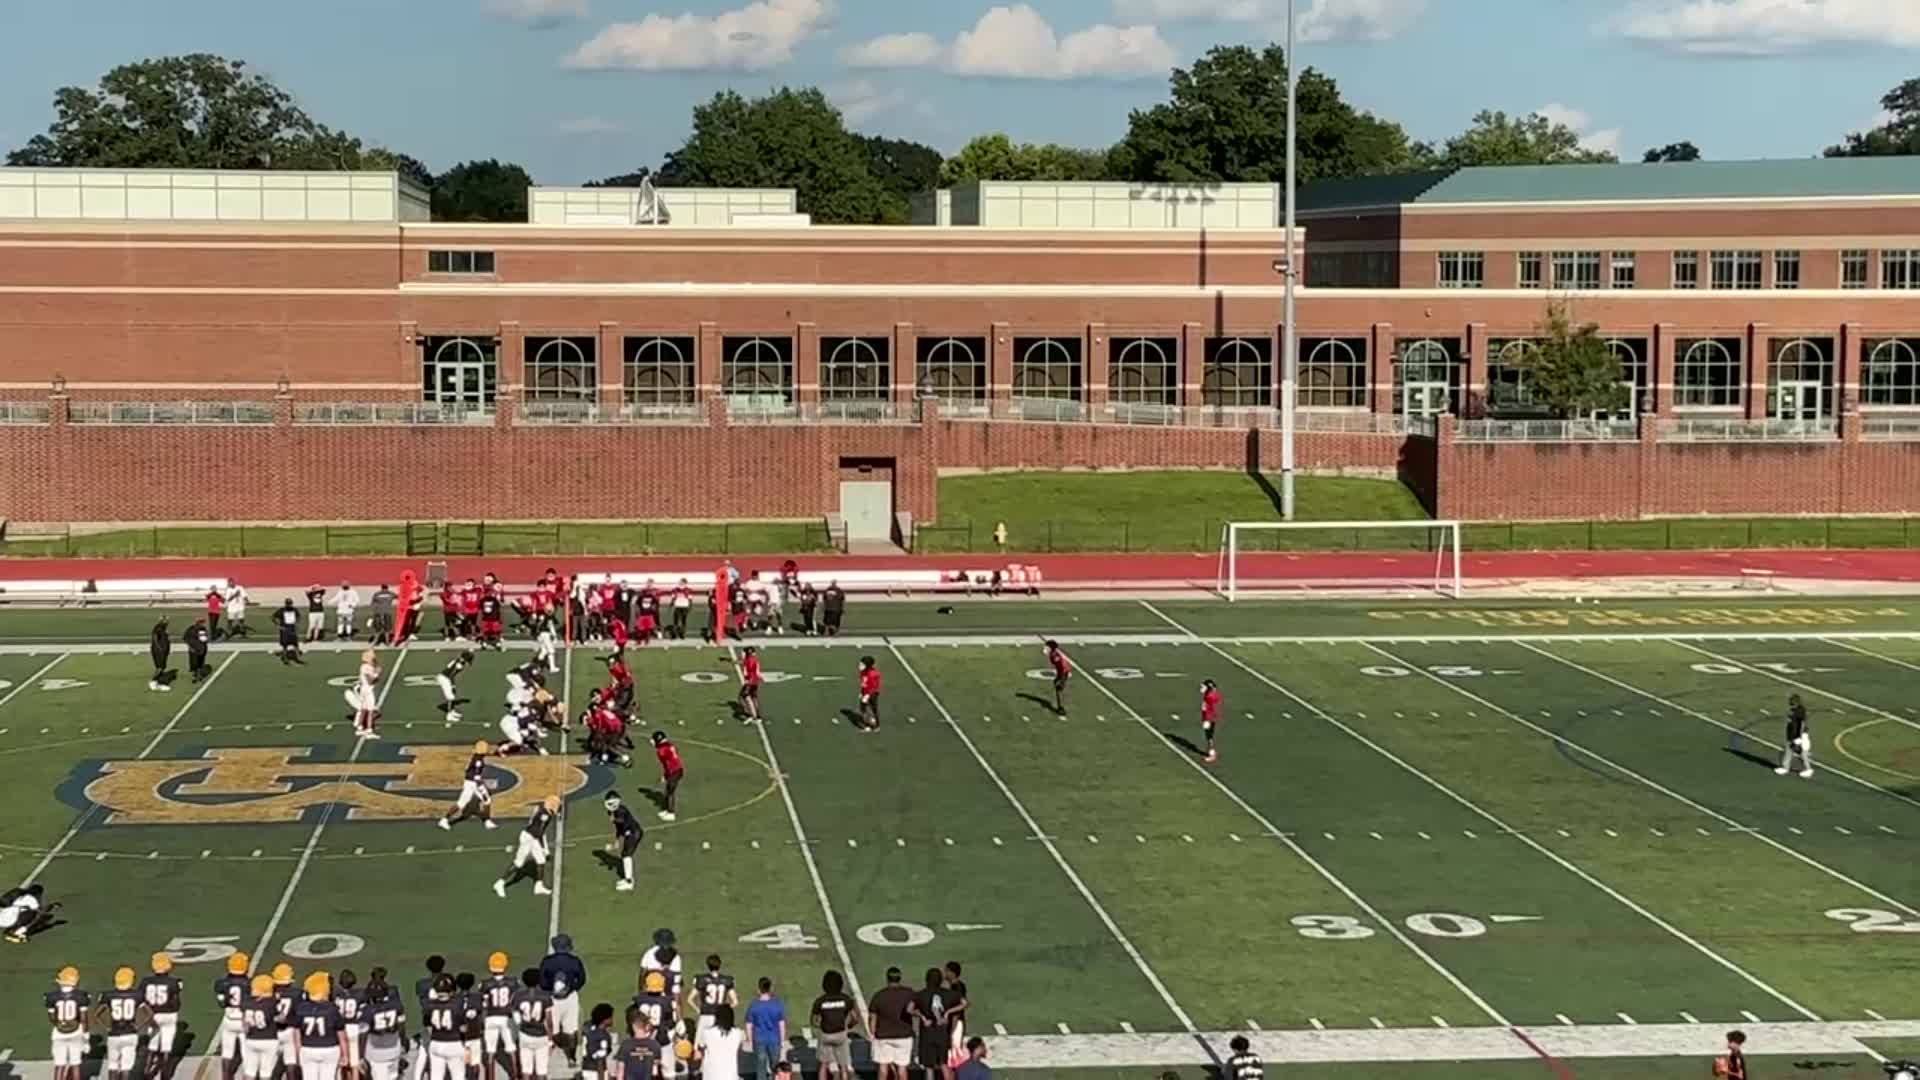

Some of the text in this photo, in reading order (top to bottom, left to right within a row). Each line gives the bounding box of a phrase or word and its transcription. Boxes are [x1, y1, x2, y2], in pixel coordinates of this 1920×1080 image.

[1361, 665, 1482, 676] 20
[1691, 663, 1802, 674] 10
[739, 922, 936, 948] 40
[1290, 913, 1487, 939] 30
[163, 934, 365, 964] 50
[228, 986, 241, 1006] 3
[705, 984, 726, 1005] 31
[55, 1000, 77, 1022] 10
[111, 998, 135, 1021] 50
[431, 1009, 452, 1031] 44
[519, 1001, 542, 1022] 34
[303, 1016, 326, 1037] 71
